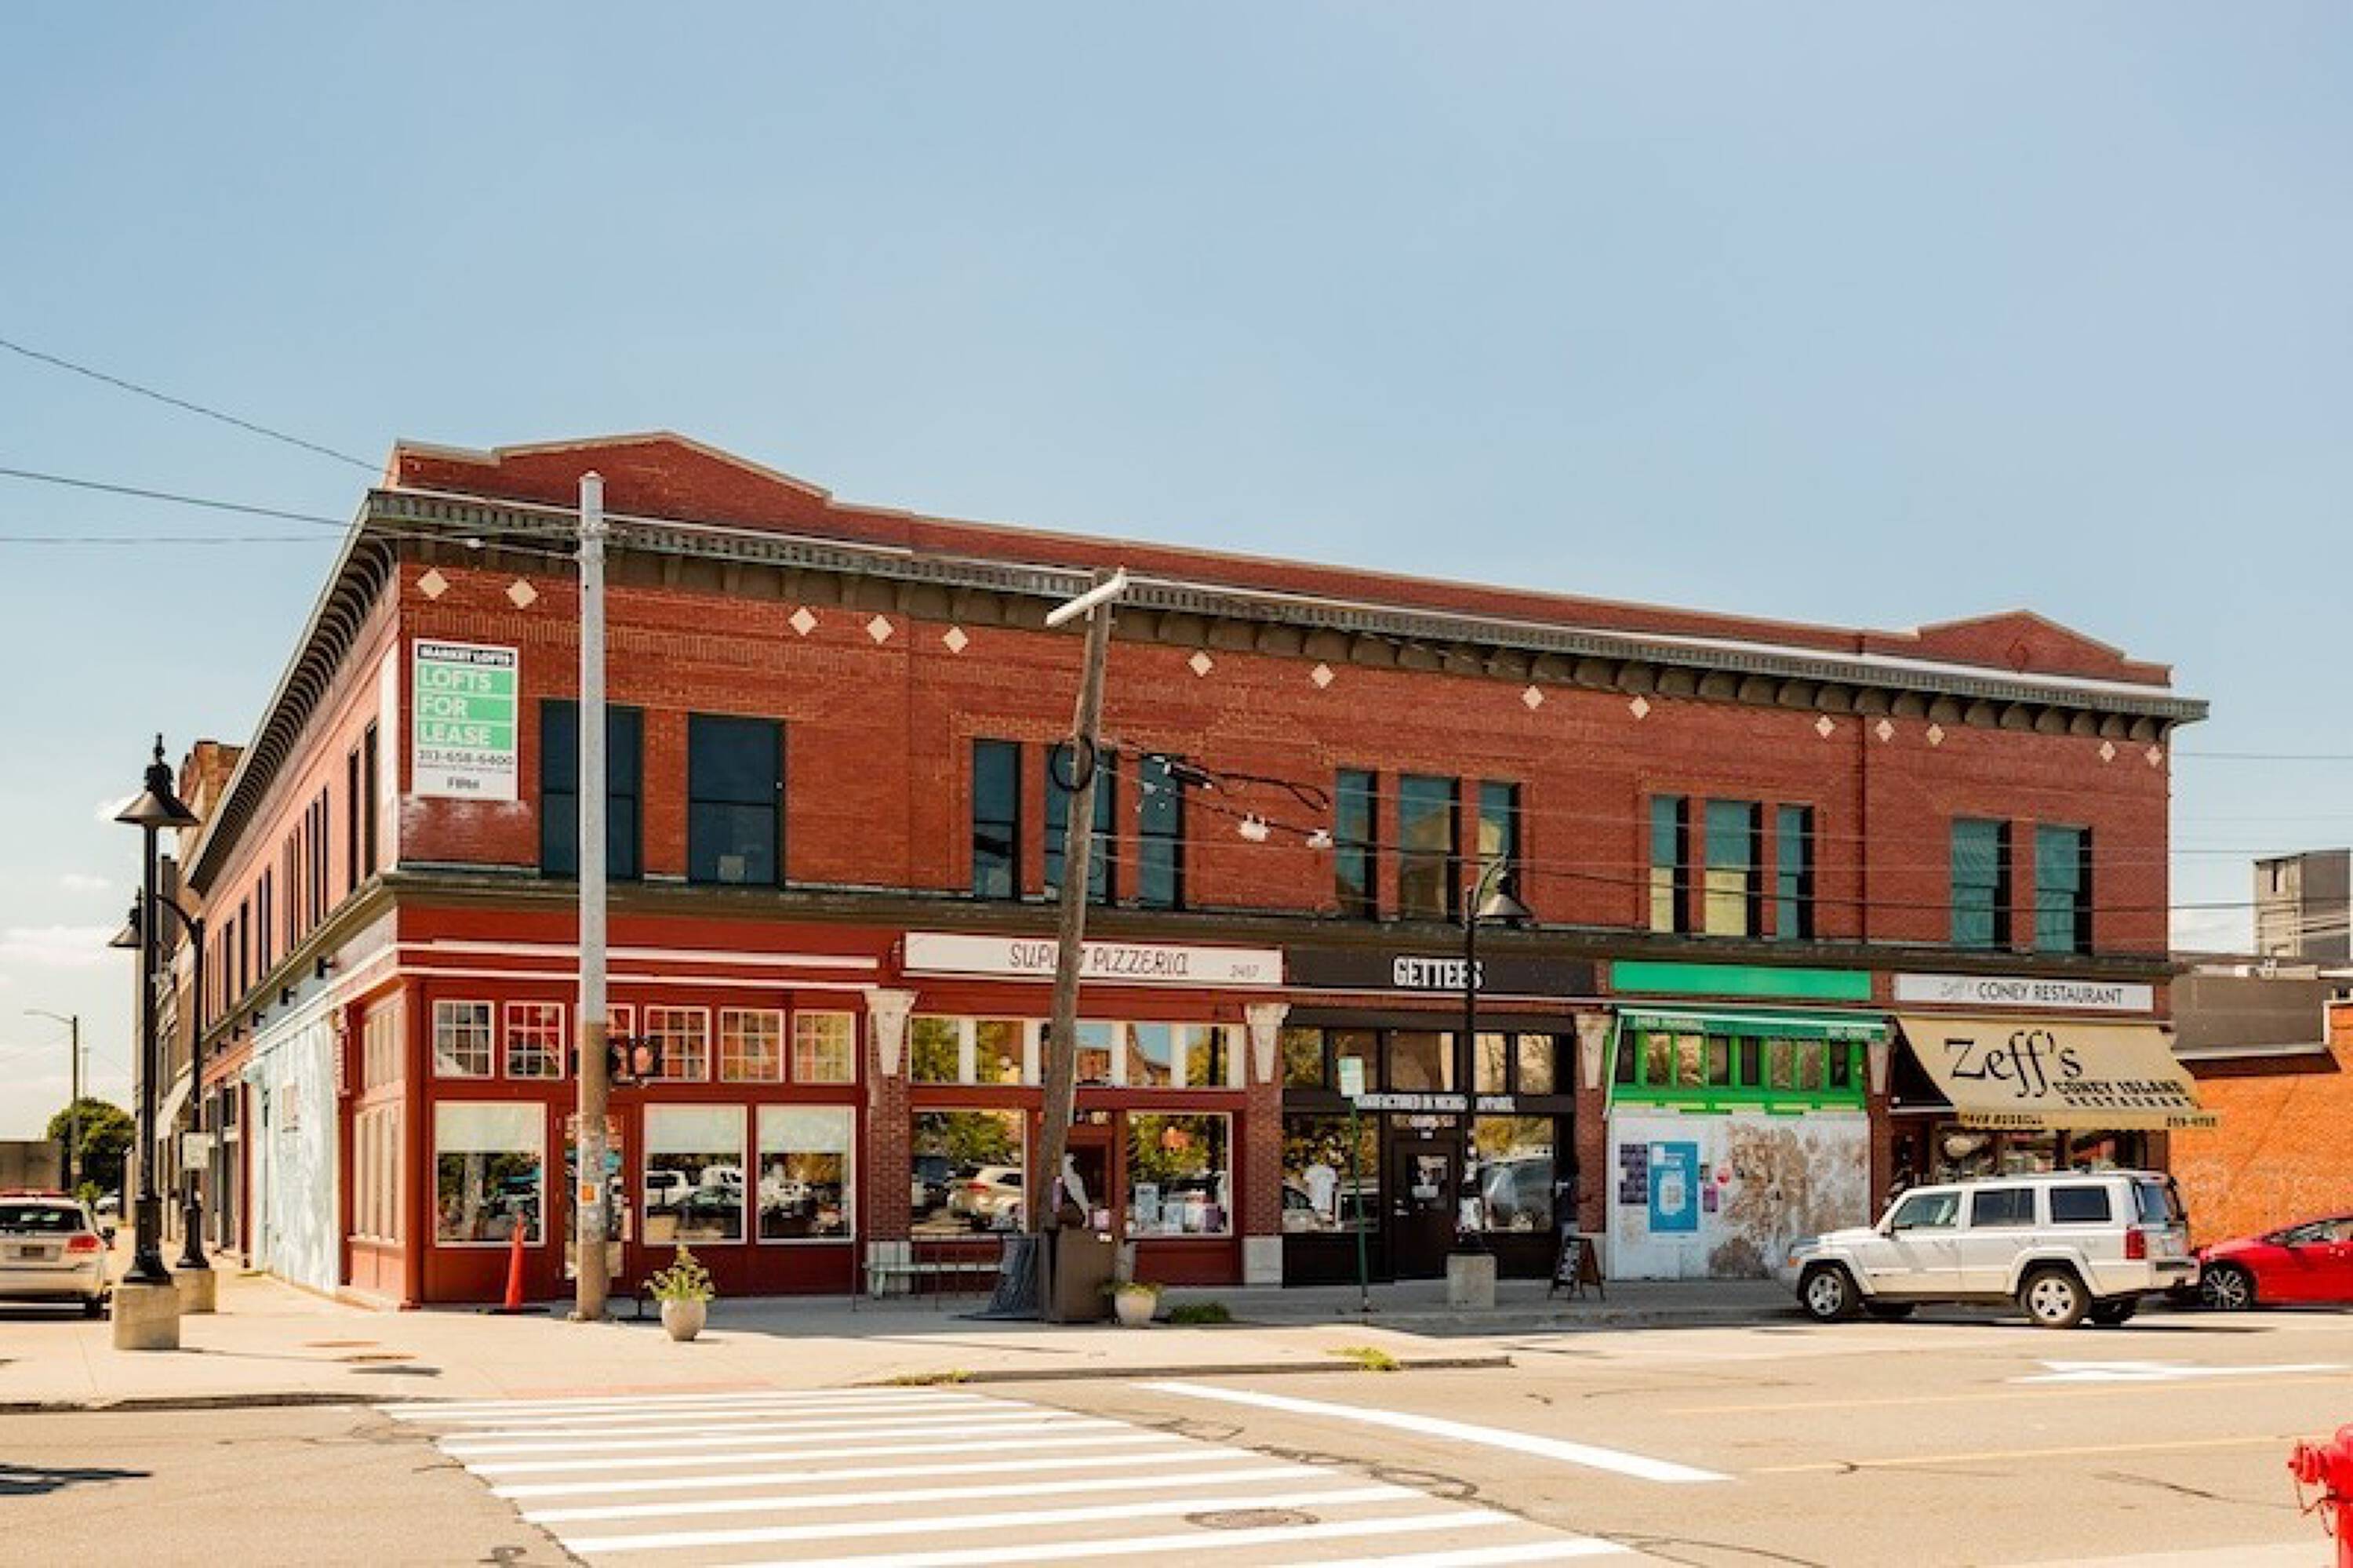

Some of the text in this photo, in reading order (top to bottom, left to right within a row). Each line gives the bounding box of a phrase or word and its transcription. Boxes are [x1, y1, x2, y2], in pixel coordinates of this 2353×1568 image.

[420, 667, 493, 690] LOFTS
[420, 696, 468, 715] FOR
[420, 721, 493, 745] LEASE
[1092, 947, 1190, 974] PIZZERIA
[1977, 982, 2030, 1001] CONEY
[2035, 984, 2124, 1004] RESTAURANT
[1944, 1030, 2083, 1098] Zeff's
